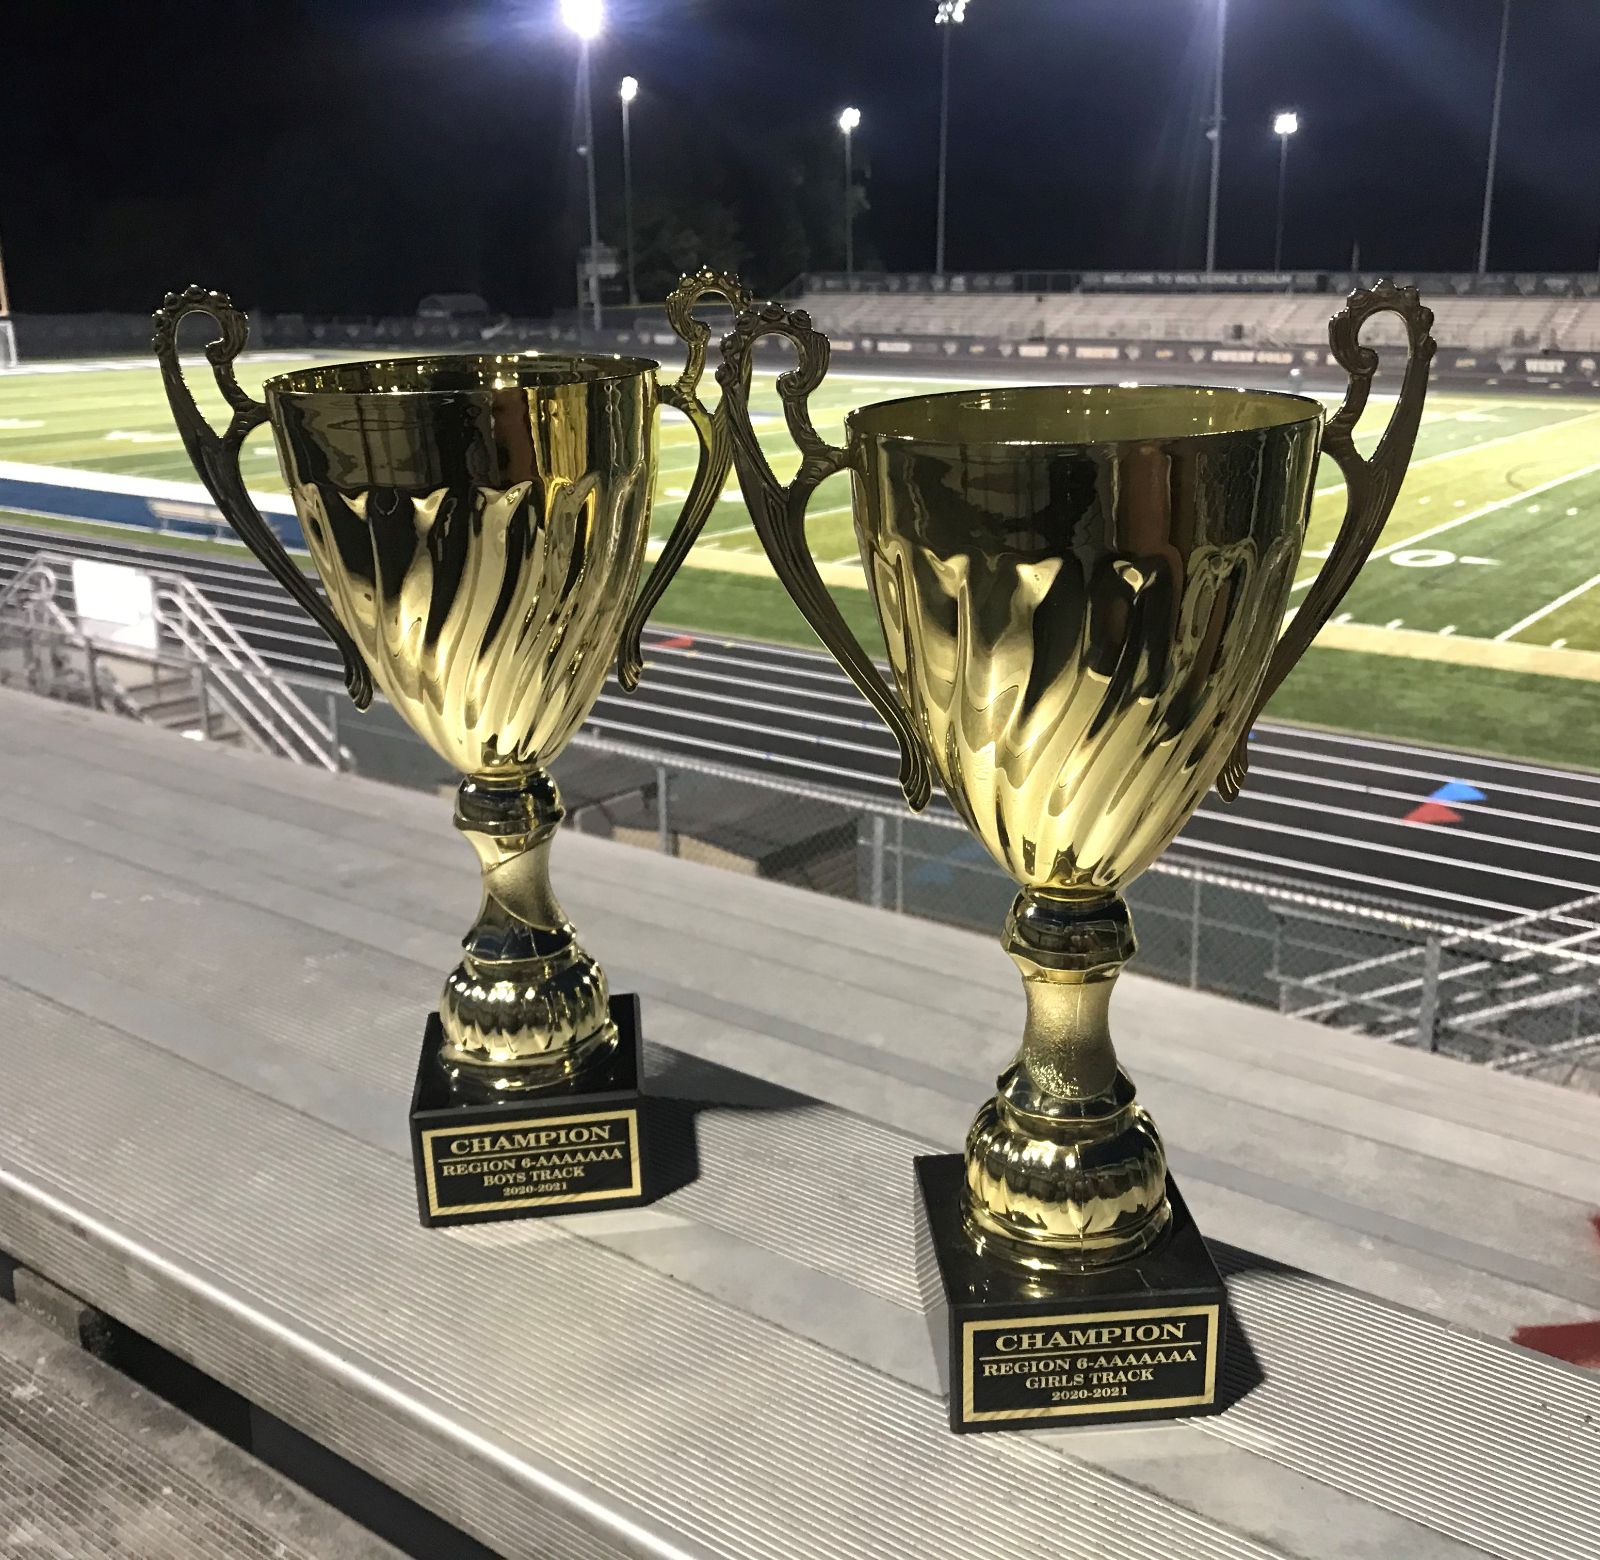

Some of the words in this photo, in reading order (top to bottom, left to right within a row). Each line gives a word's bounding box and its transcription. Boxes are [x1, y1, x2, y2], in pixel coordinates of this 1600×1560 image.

[450, 1125, 611, 1155] CHAMPION
[442, 1158, 516, 1177] REGION
[521, 1148, 623, 1169] 6-AAAAAAA
[483, 1171, 526, 1187] BOYS
[530, 1165, 585, 1181] TRACK
[503, 1182, 568, 1196] 2020-2021
[995, 1322, 1187, 1353] CHAMPION
[983, 1357, 1071, 1377] REGION
[1076, 1349, 1198, 1370] 6-AAAAAAA
[1025, 1373, 1085, 1390] GIRLS
[1089, 1368, 1155, 1383] TRACK
[1051, 1386, 1129, 1401] 2020-2021
